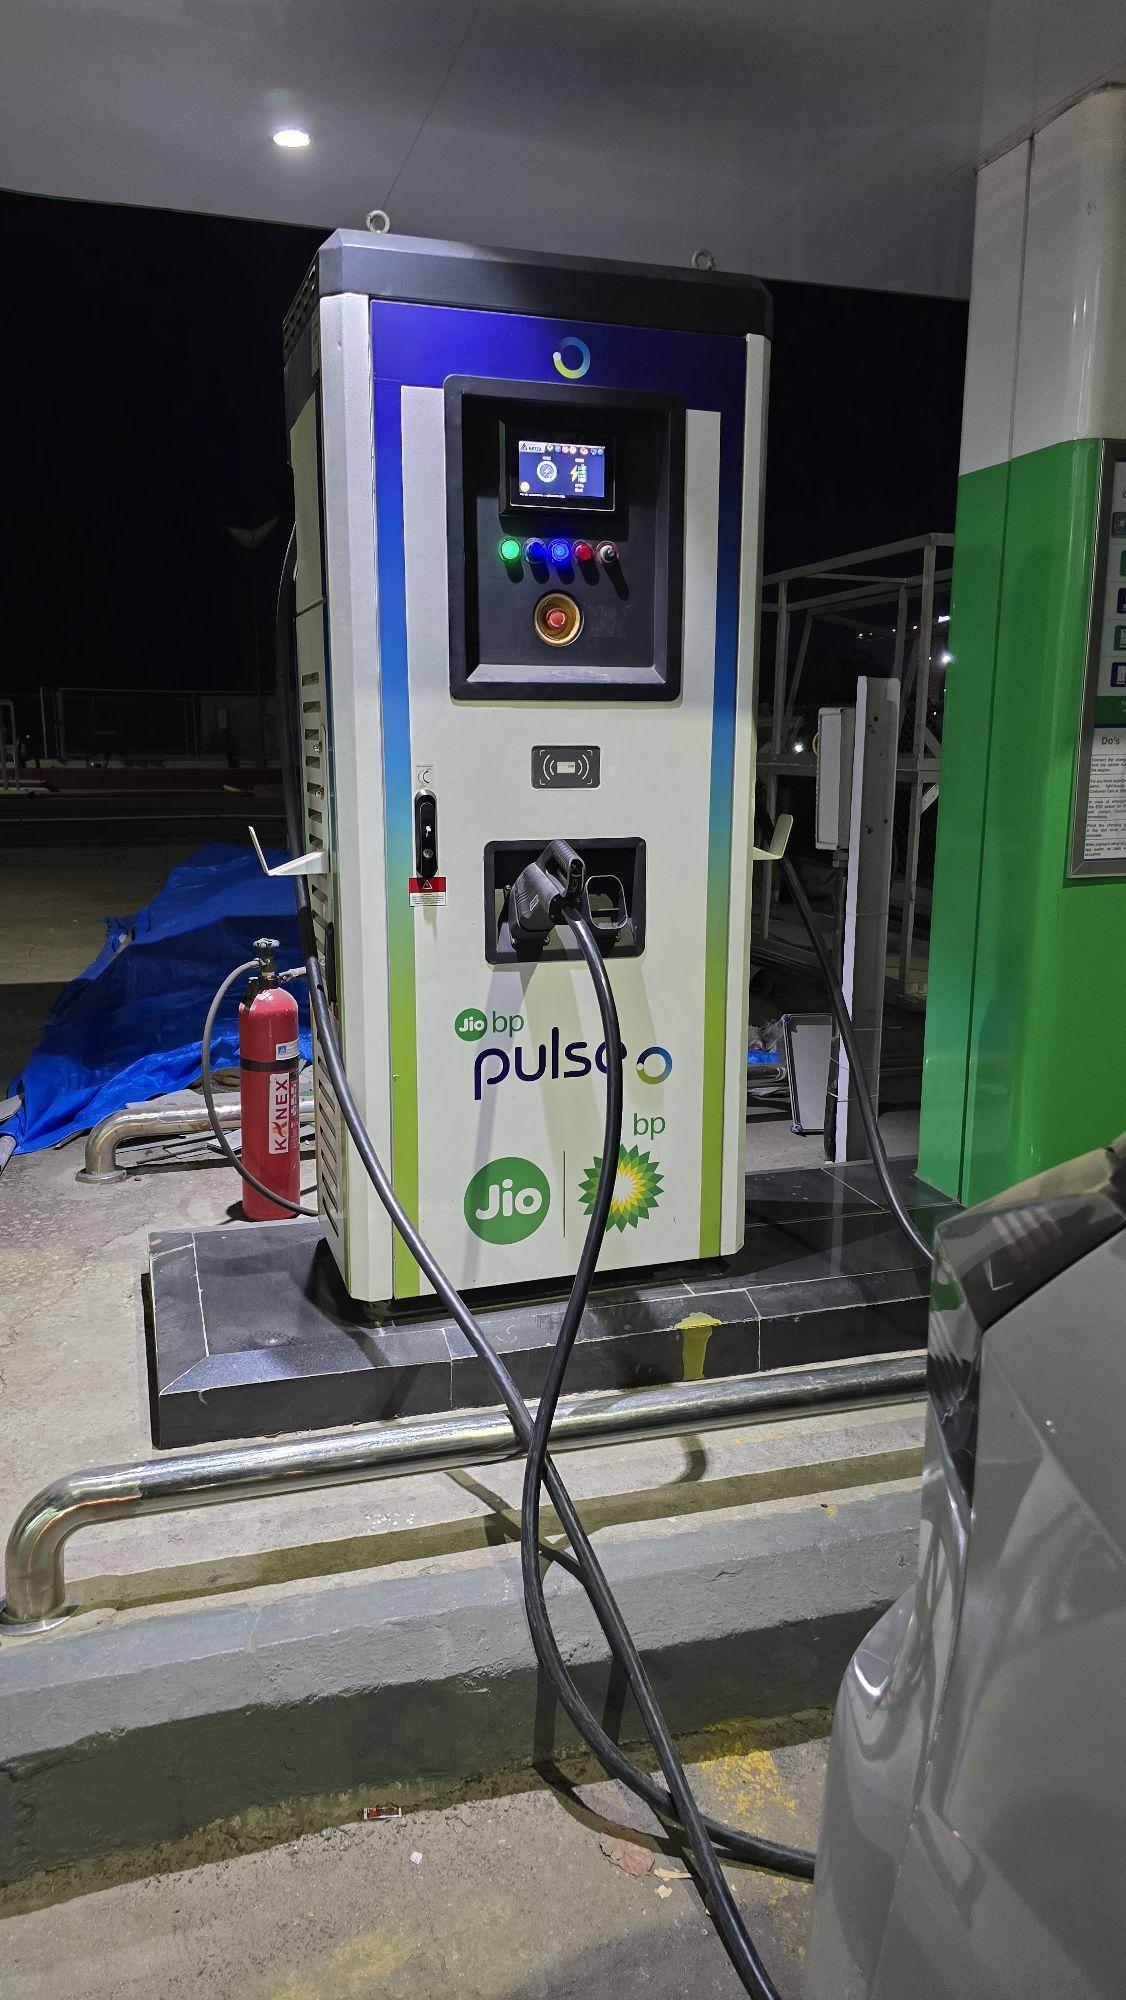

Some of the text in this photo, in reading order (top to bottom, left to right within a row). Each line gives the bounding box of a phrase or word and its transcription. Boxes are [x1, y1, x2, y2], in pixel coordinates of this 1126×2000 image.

[1101, 736, 1121, 745] Do's
[459, 1011, 525, 1037] Jio bp
[633, 1112, 666, 1140] bp
[475, 1178, 543, 1220] Jio
